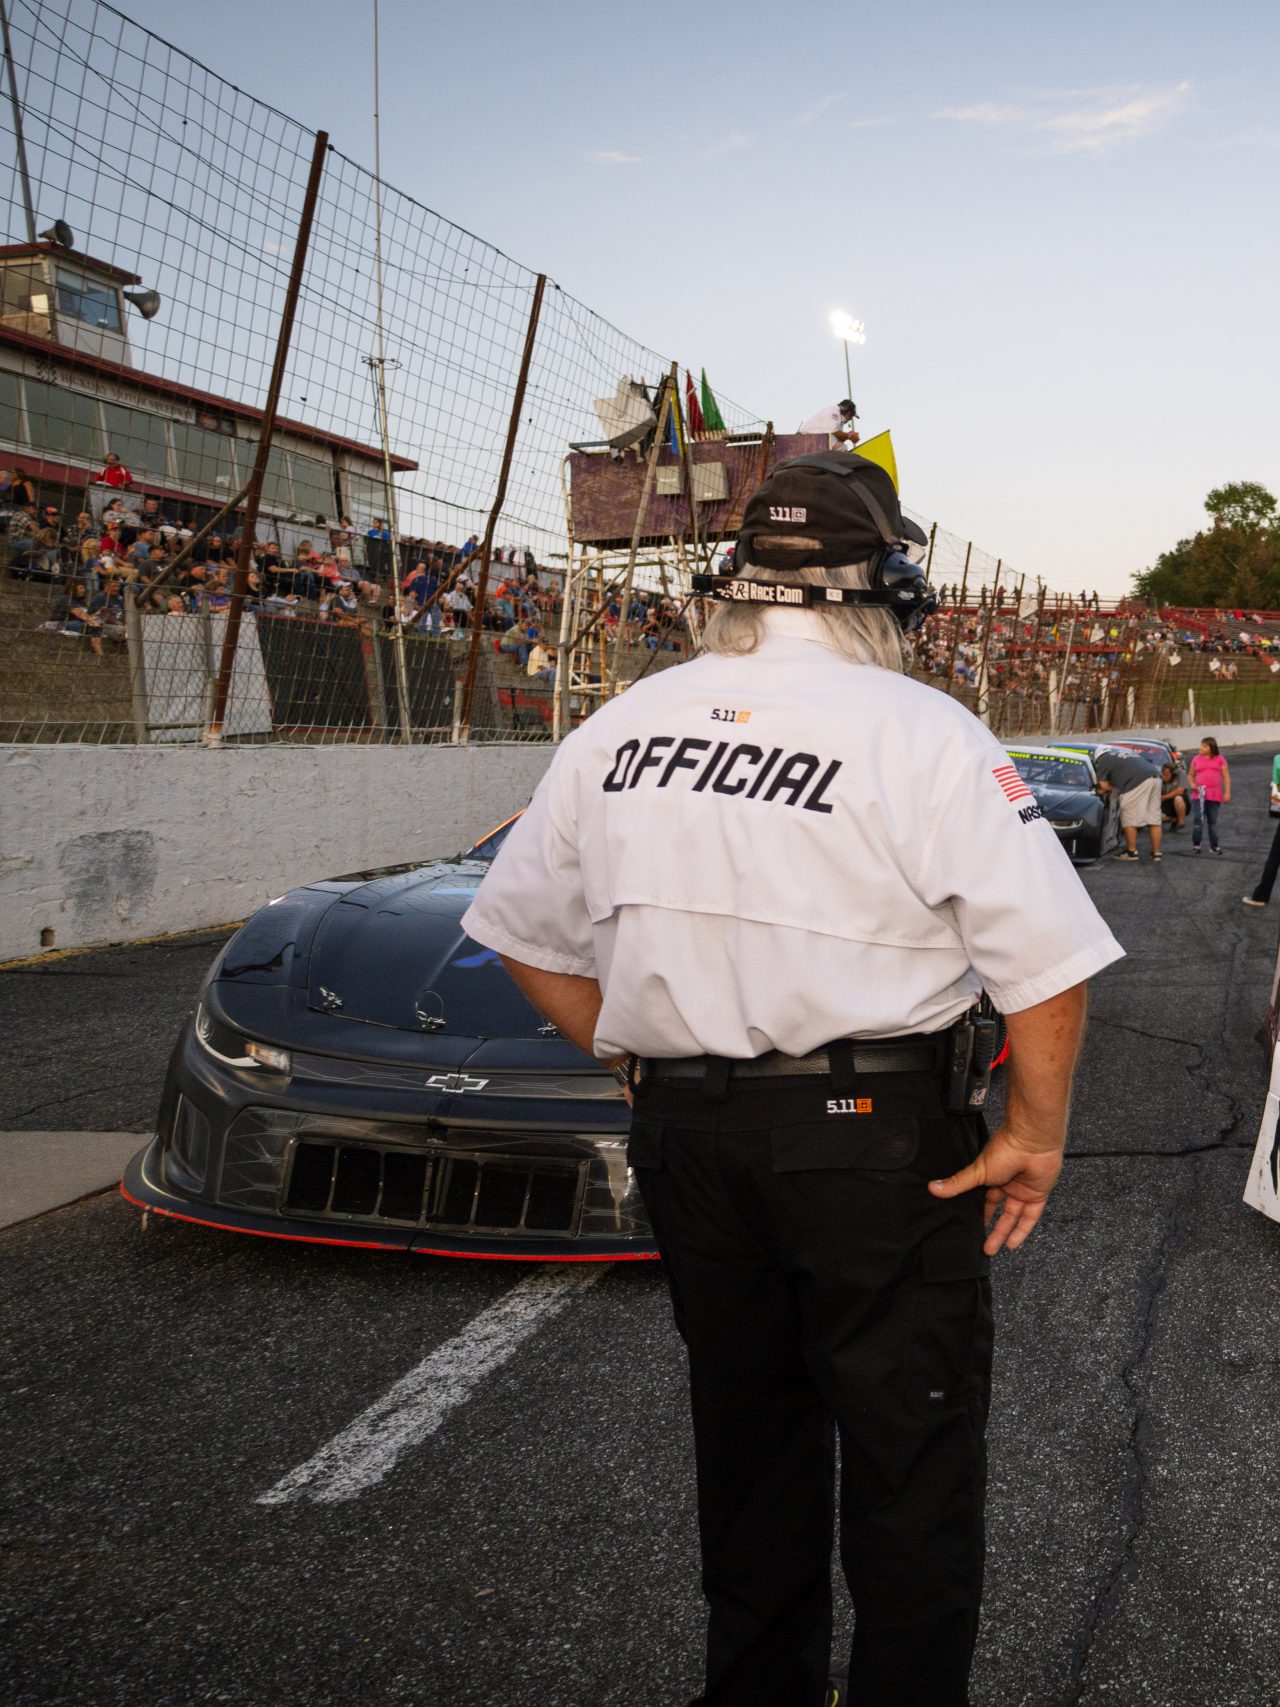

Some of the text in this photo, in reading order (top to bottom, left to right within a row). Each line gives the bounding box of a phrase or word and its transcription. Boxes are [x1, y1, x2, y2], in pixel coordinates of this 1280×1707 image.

[711, 708, 736, 722] 5.11
[602, 736, 843, 814] OFFICIAL
[826, 1099, 857, 1114] 5.11
